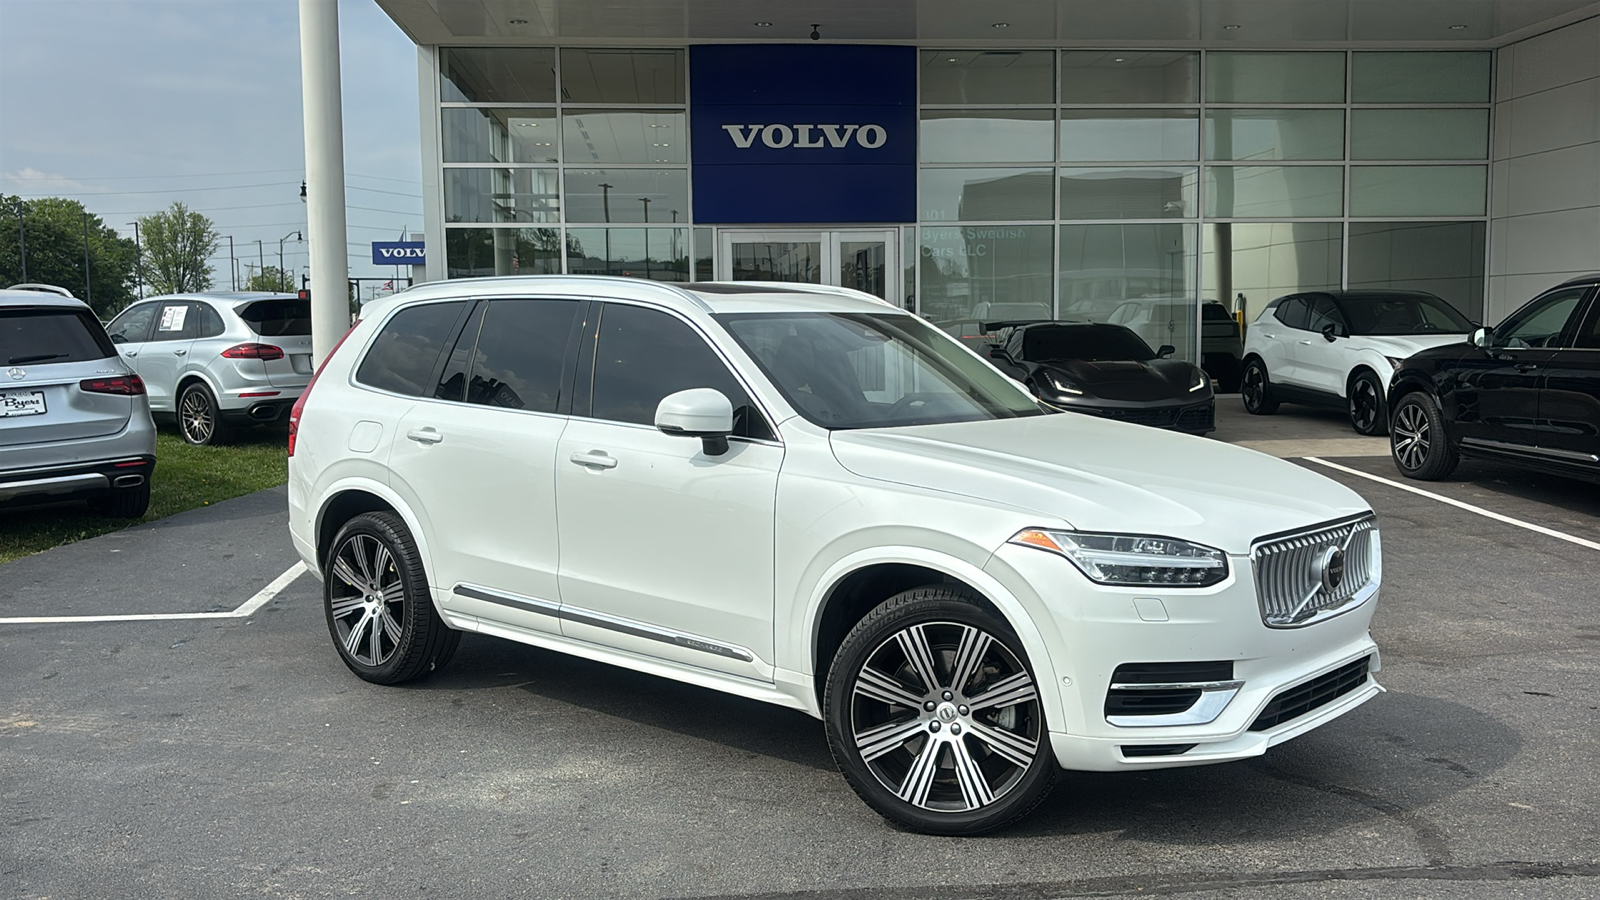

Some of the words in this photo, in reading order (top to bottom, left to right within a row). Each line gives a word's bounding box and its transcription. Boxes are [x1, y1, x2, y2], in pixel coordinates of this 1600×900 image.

[721, 124, 887, 149] VOLVO
[922, 228, 960, 242] Byers
[966, 228, 1026, 239] Swedish
[921, 245, 954, 257] Cars
[3, 397, 41, 409] Byers
